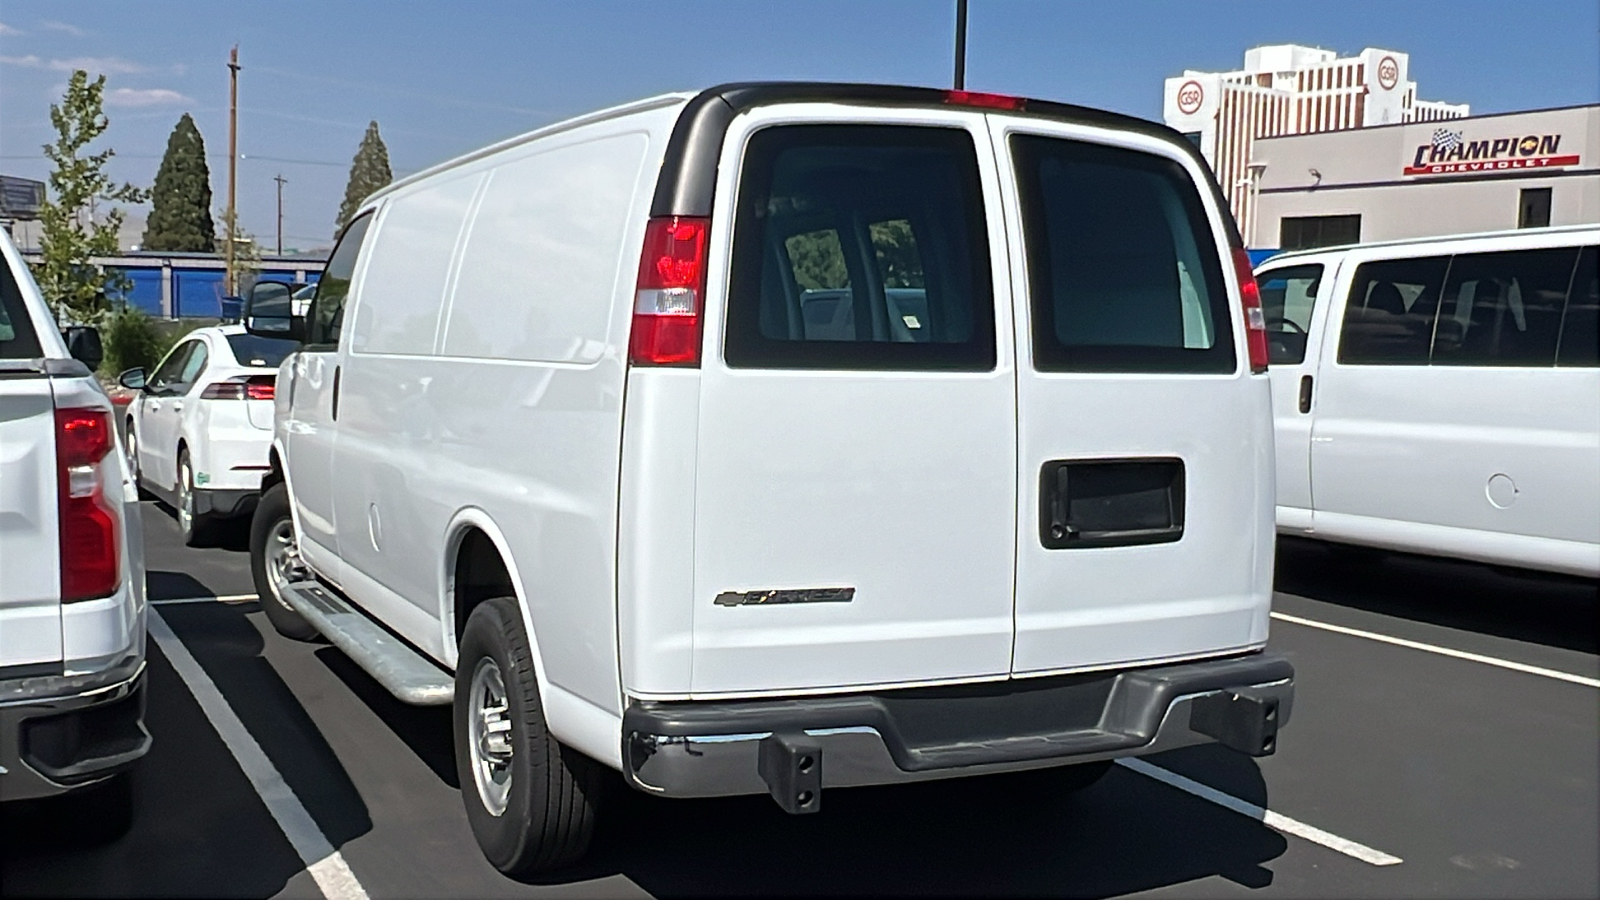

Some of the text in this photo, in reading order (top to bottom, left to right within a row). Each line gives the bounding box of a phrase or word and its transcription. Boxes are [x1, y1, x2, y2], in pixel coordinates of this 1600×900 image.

[1181, 91, 1199, 105] GSR
[1412, 134, 1561, 169] CHAMPION
[1431, 158, 1551, 173] CHEVROLET
